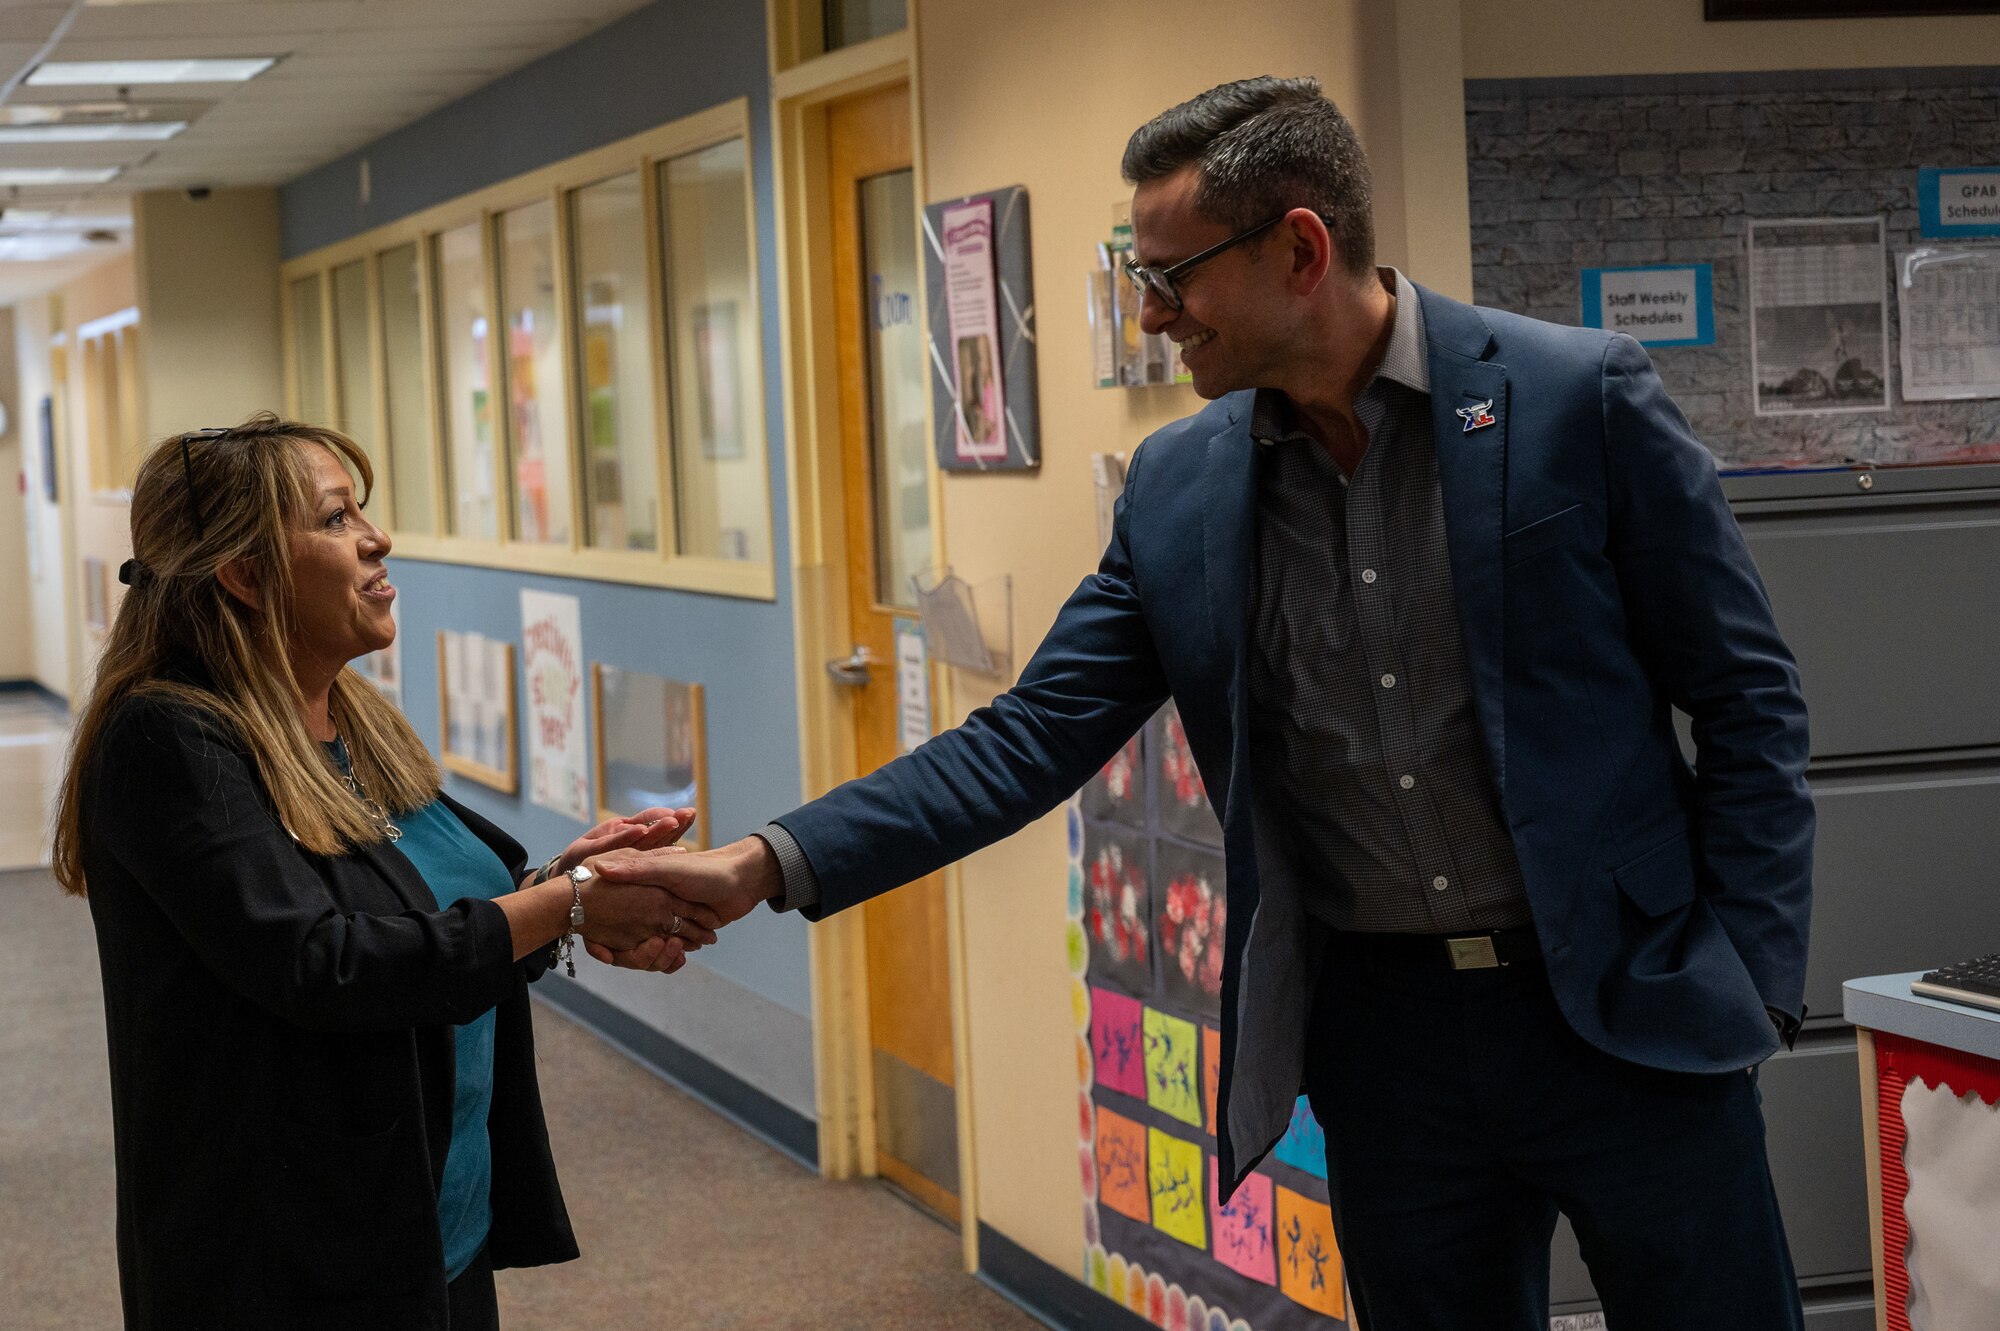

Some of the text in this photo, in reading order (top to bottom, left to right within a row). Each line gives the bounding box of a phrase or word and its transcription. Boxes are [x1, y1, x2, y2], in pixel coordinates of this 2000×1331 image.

[1961, 184, 1997, 199] GPAB
[1947, 203, 2000, 218] Schedul
[1607, 290, 1689, 307] Staff Weekly
[1615, 311, 1684, 326] Schedules
